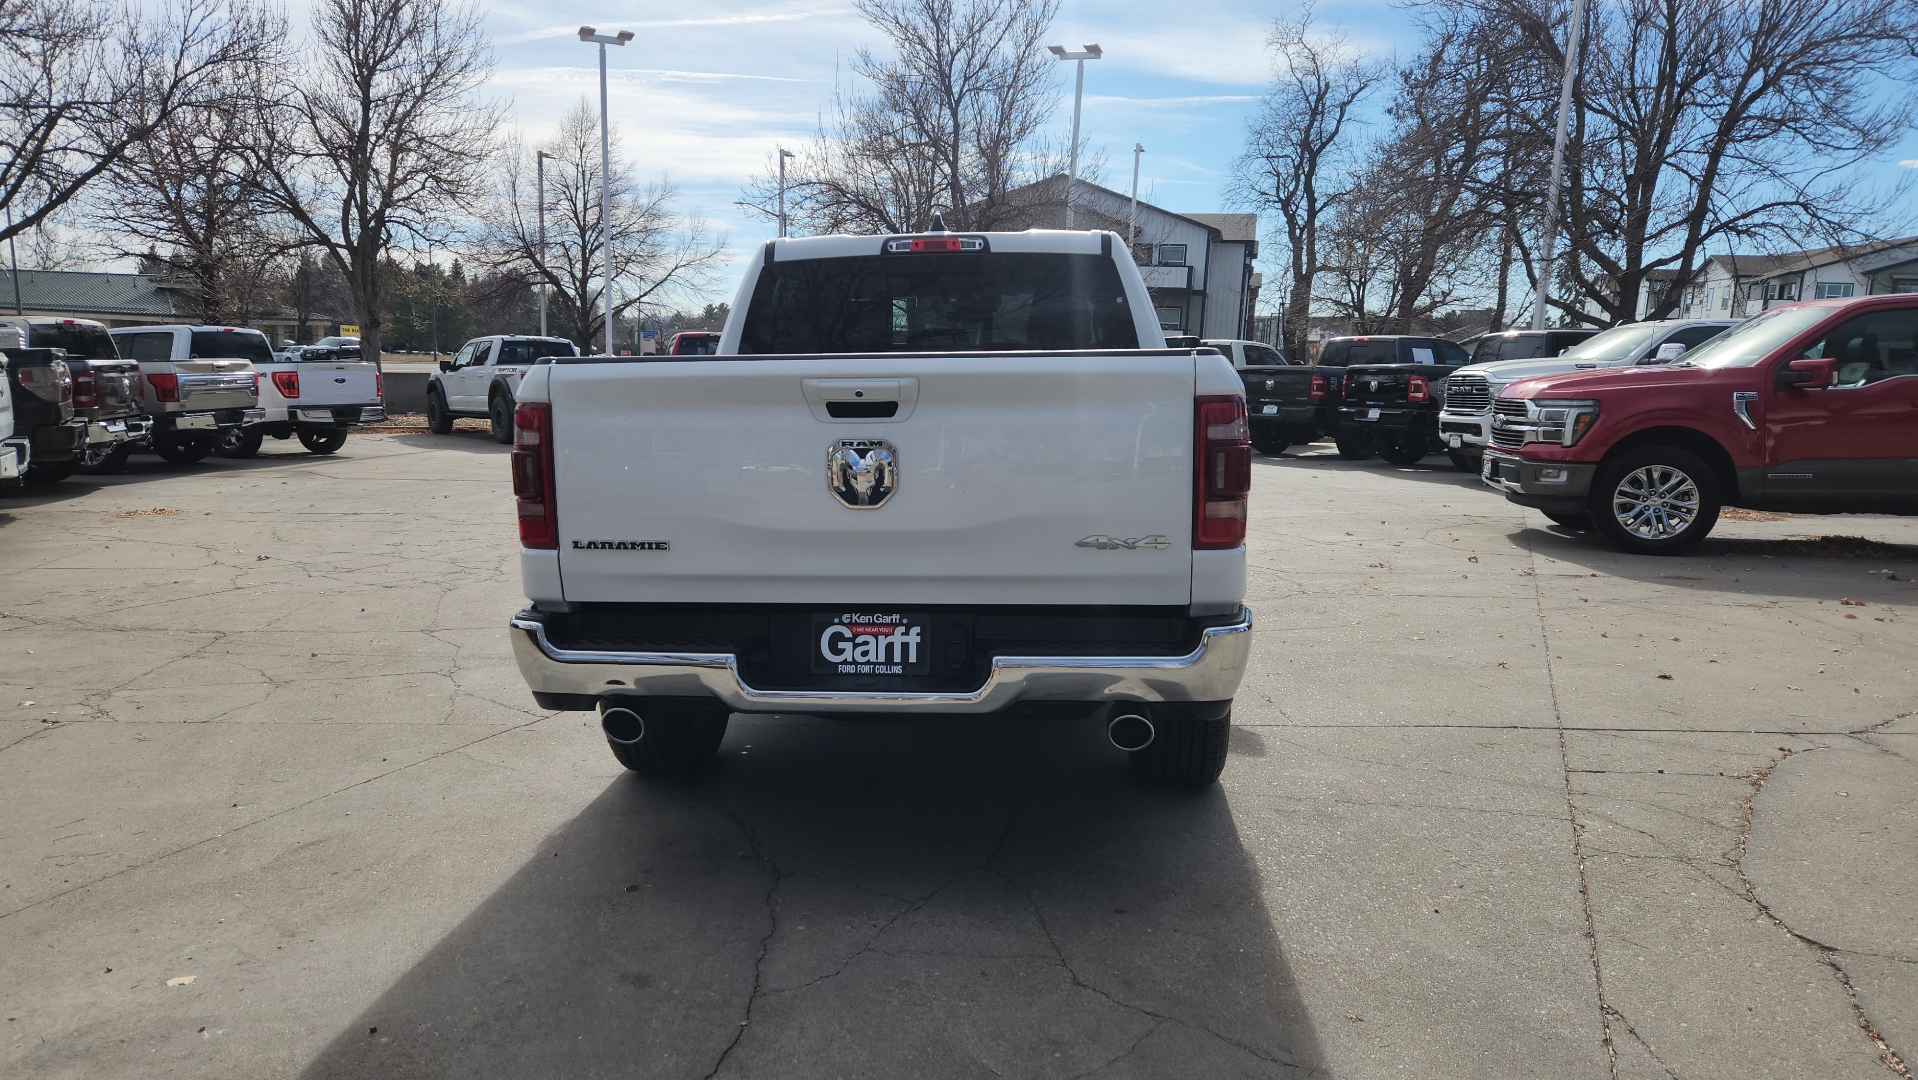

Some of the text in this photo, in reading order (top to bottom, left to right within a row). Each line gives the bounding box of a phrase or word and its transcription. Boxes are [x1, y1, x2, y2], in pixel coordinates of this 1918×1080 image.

[572, 540, 670, 551] LARAMIE
[852, 613, 901, 624] Ken Garff
[820, 624, 921, 663] Garff
[838, 664, 903, 674] FORD FORT COLLINS
